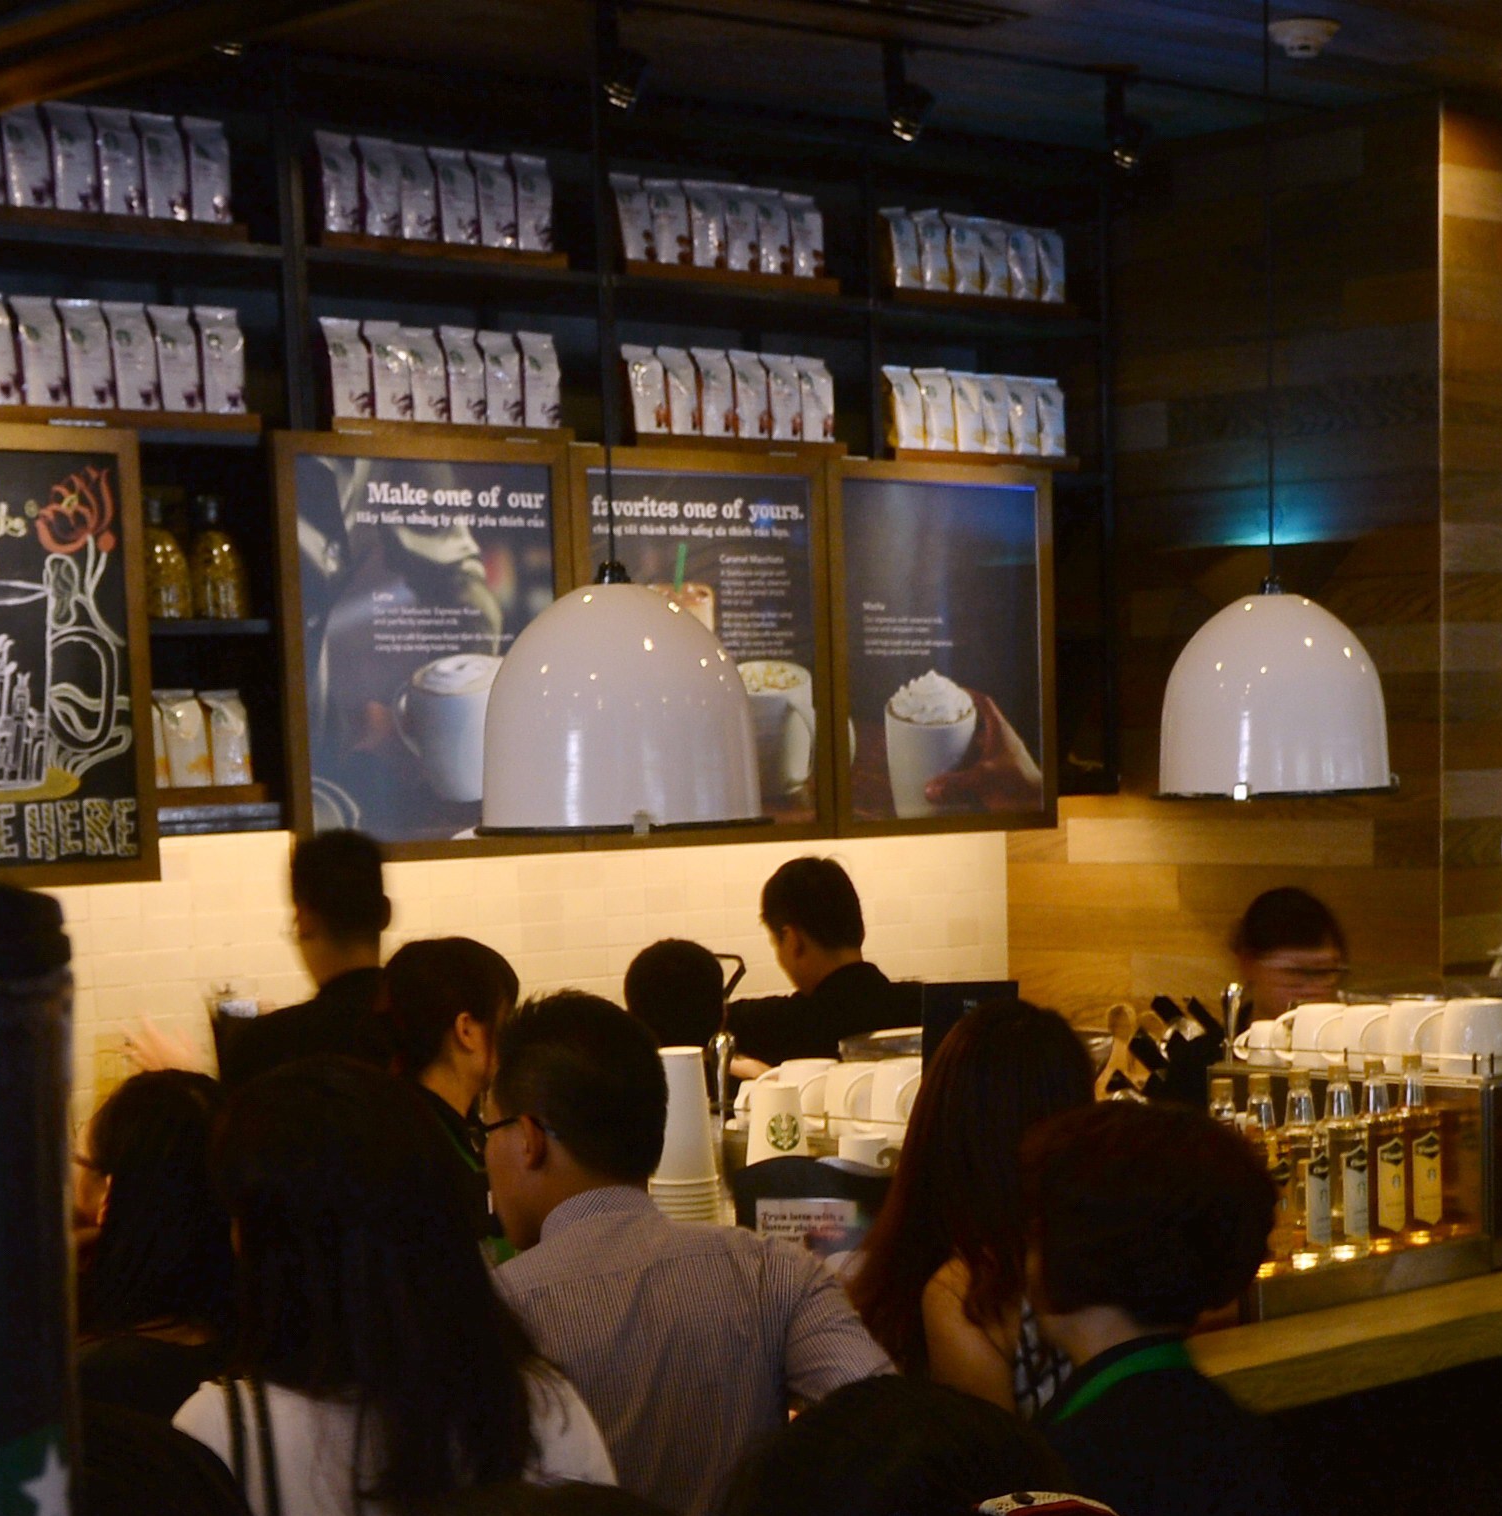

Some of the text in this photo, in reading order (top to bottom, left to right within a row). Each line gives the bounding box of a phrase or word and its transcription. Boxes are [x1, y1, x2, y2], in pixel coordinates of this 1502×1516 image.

[366, 482, 546, 510] Make one of our
[591, 494, 805, 523] favorites one of yours.
[24, 798, 138, 861] HERE
